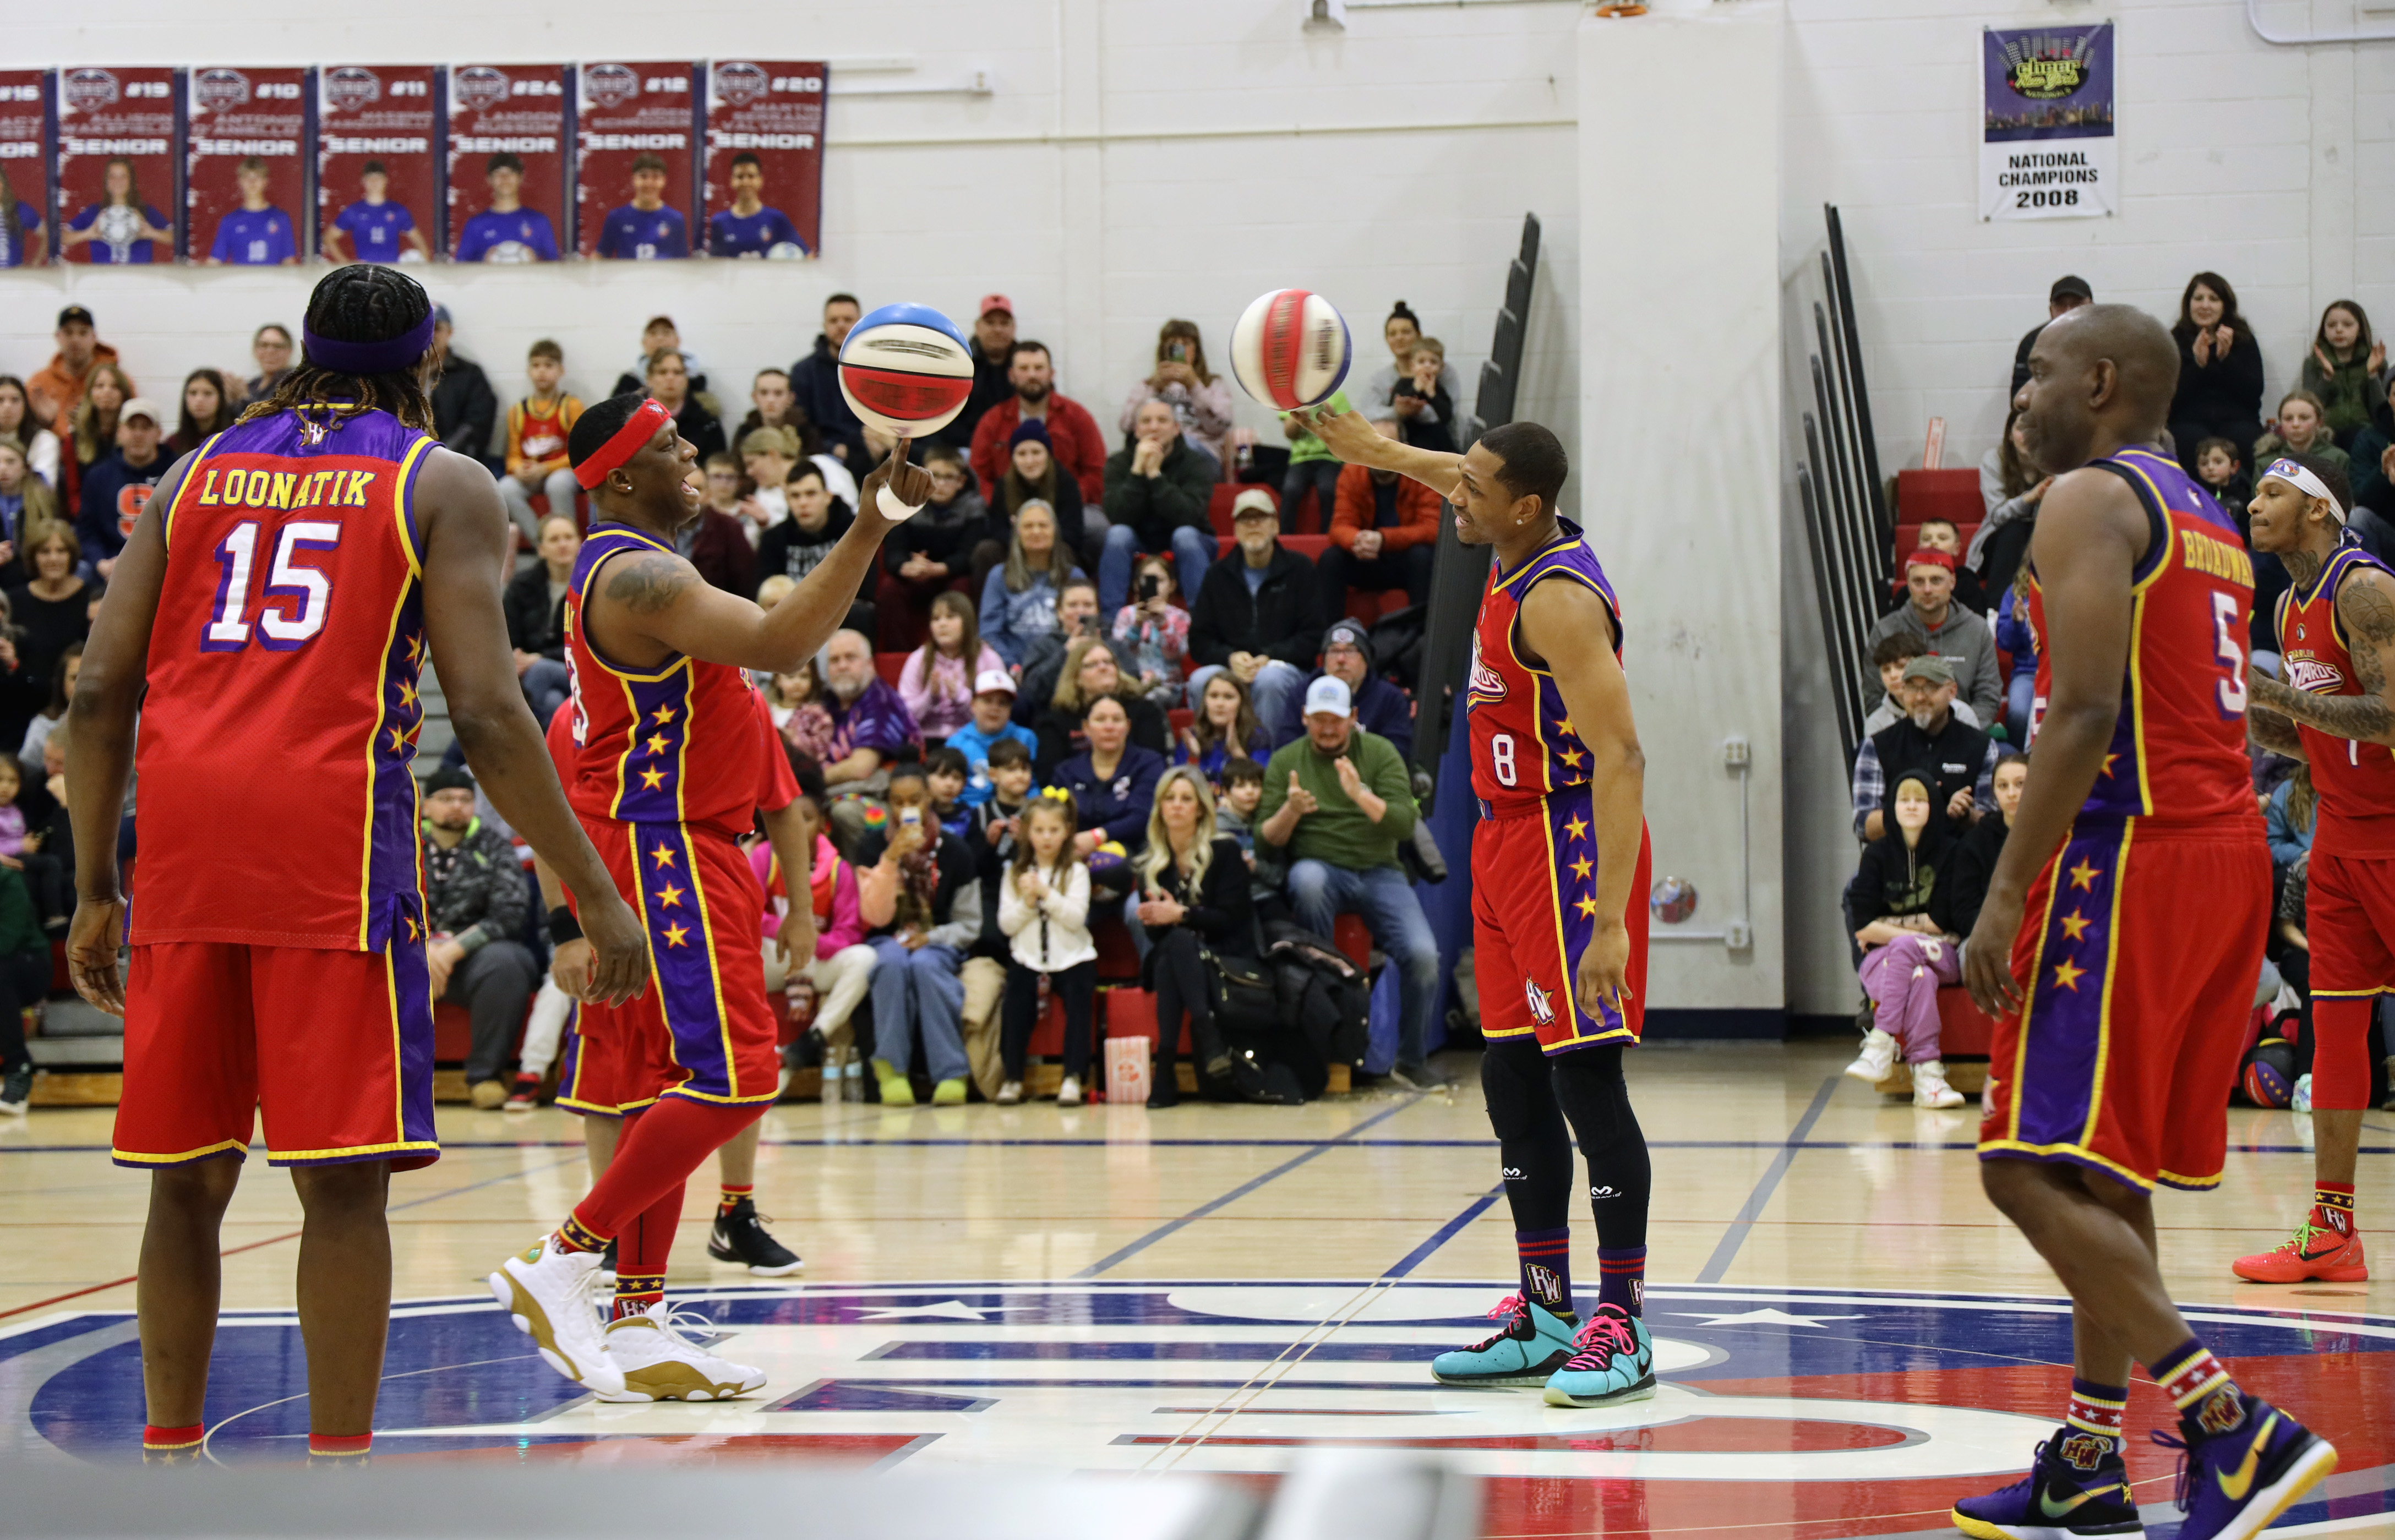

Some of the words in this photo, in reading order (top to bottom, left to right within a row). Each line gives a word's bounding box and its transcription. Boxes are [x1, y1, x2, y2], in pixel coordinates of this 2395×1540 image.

[256, 84, 300, 99] #10
[390, 81, 427, 96] #11
[511, 80, 563, 96] #24
[645, 77, 688, 92] #12
[772, 77, 822, 92] #20
[66, 139, 167, 155] SENIOR
[196, 139, 297, 155] SENIOR
[328, 138, 427, 154] SENIOR
[456, 137, 556, 153] SENIOR
[585, 134, 686, 150] SENIOR
[715, 133, 814, 149] SENIOR
[2009, 151, 2088, 168] NATIONAL
[1999, 168, 2098, 187] CHAMPIONS
[2016, 190, 2079, 208] 2008
[198, 468, 378, 511] LOONATIK
[2180, 529, 2256, 589] BROADWA
[200, 520, 346, 652] 15
[2210, 589, 2248, 719] 5
[1491, 733, 1519, 788] 8
[1526, 1263, 1561, 1304] HW
